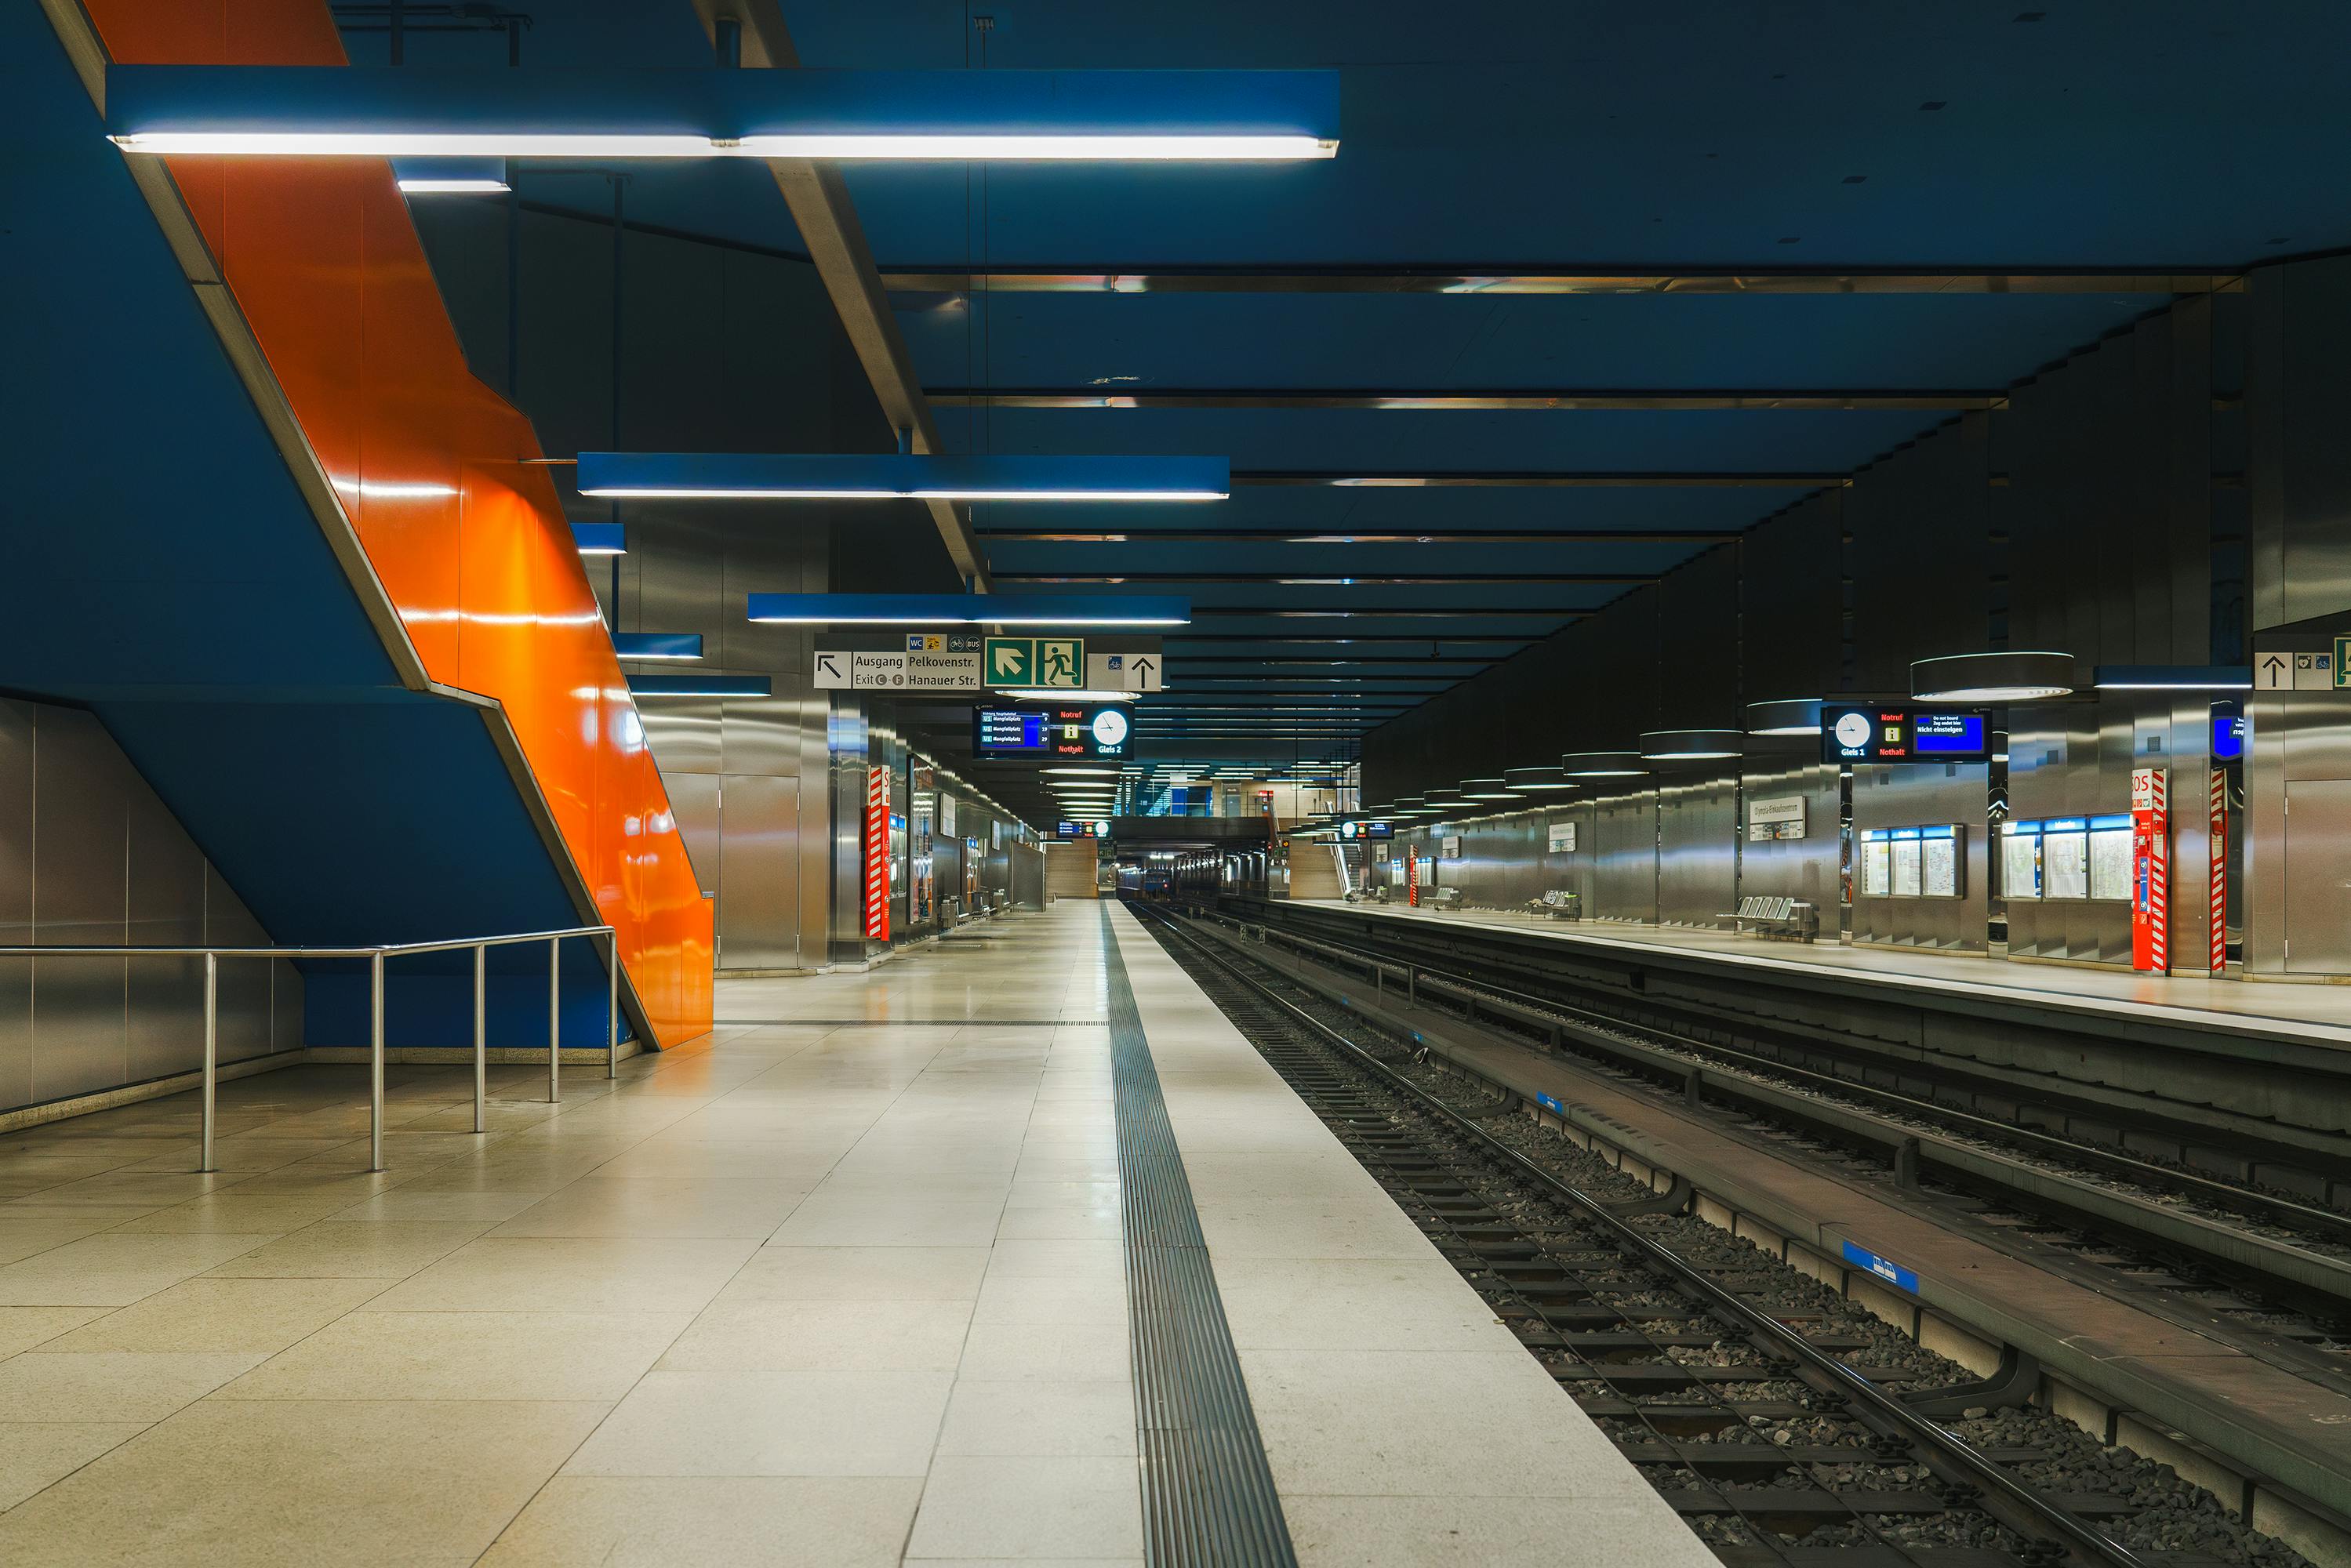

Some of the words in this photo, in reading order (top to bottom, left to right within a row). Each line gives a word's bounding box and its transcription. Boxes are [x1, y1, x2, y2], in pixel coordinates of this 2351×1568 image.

[856, 656, 903, 669] Ausgang
[909, 656, 974, 667] Pelkovenstr.
[856, 674, 874, 684] Exit
[909, 675, 955, 685] Hanauer
[958, 675, 976, 686] Str.
[2132, 775, 2149, 792] OS
